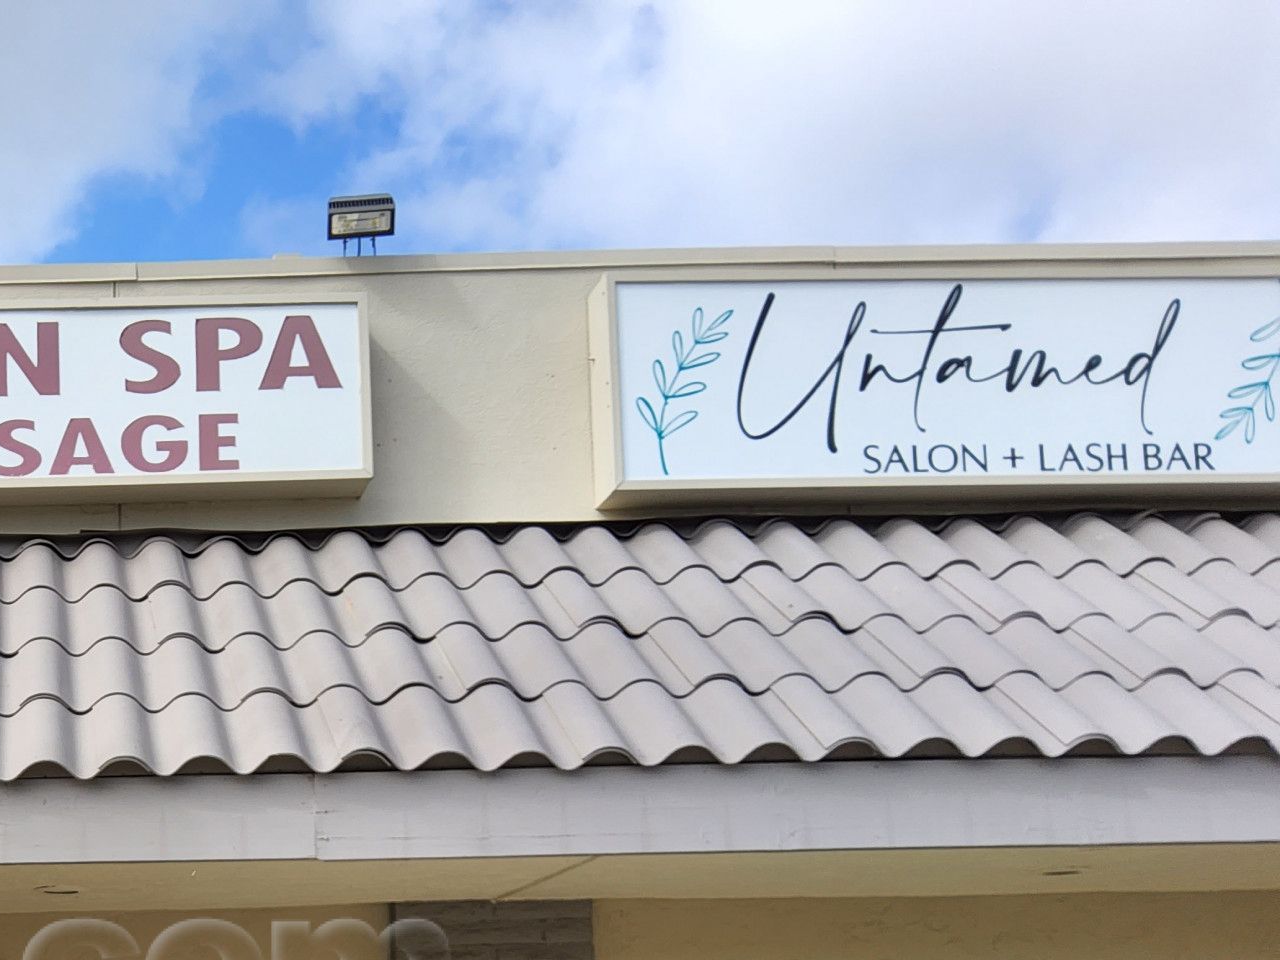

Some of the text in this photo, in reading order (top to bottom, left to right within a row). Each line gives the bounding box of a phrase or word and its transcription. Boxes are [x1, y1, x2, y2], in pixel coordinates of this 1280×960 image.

[119, 315, 343, 395] SPA
[736, 283, 1182, 454] Untamed
[862, 444, 989, 474] SALON
[1038, 443, 1128, 472] LASH
[1143, 442, 1216, 472] BAR
